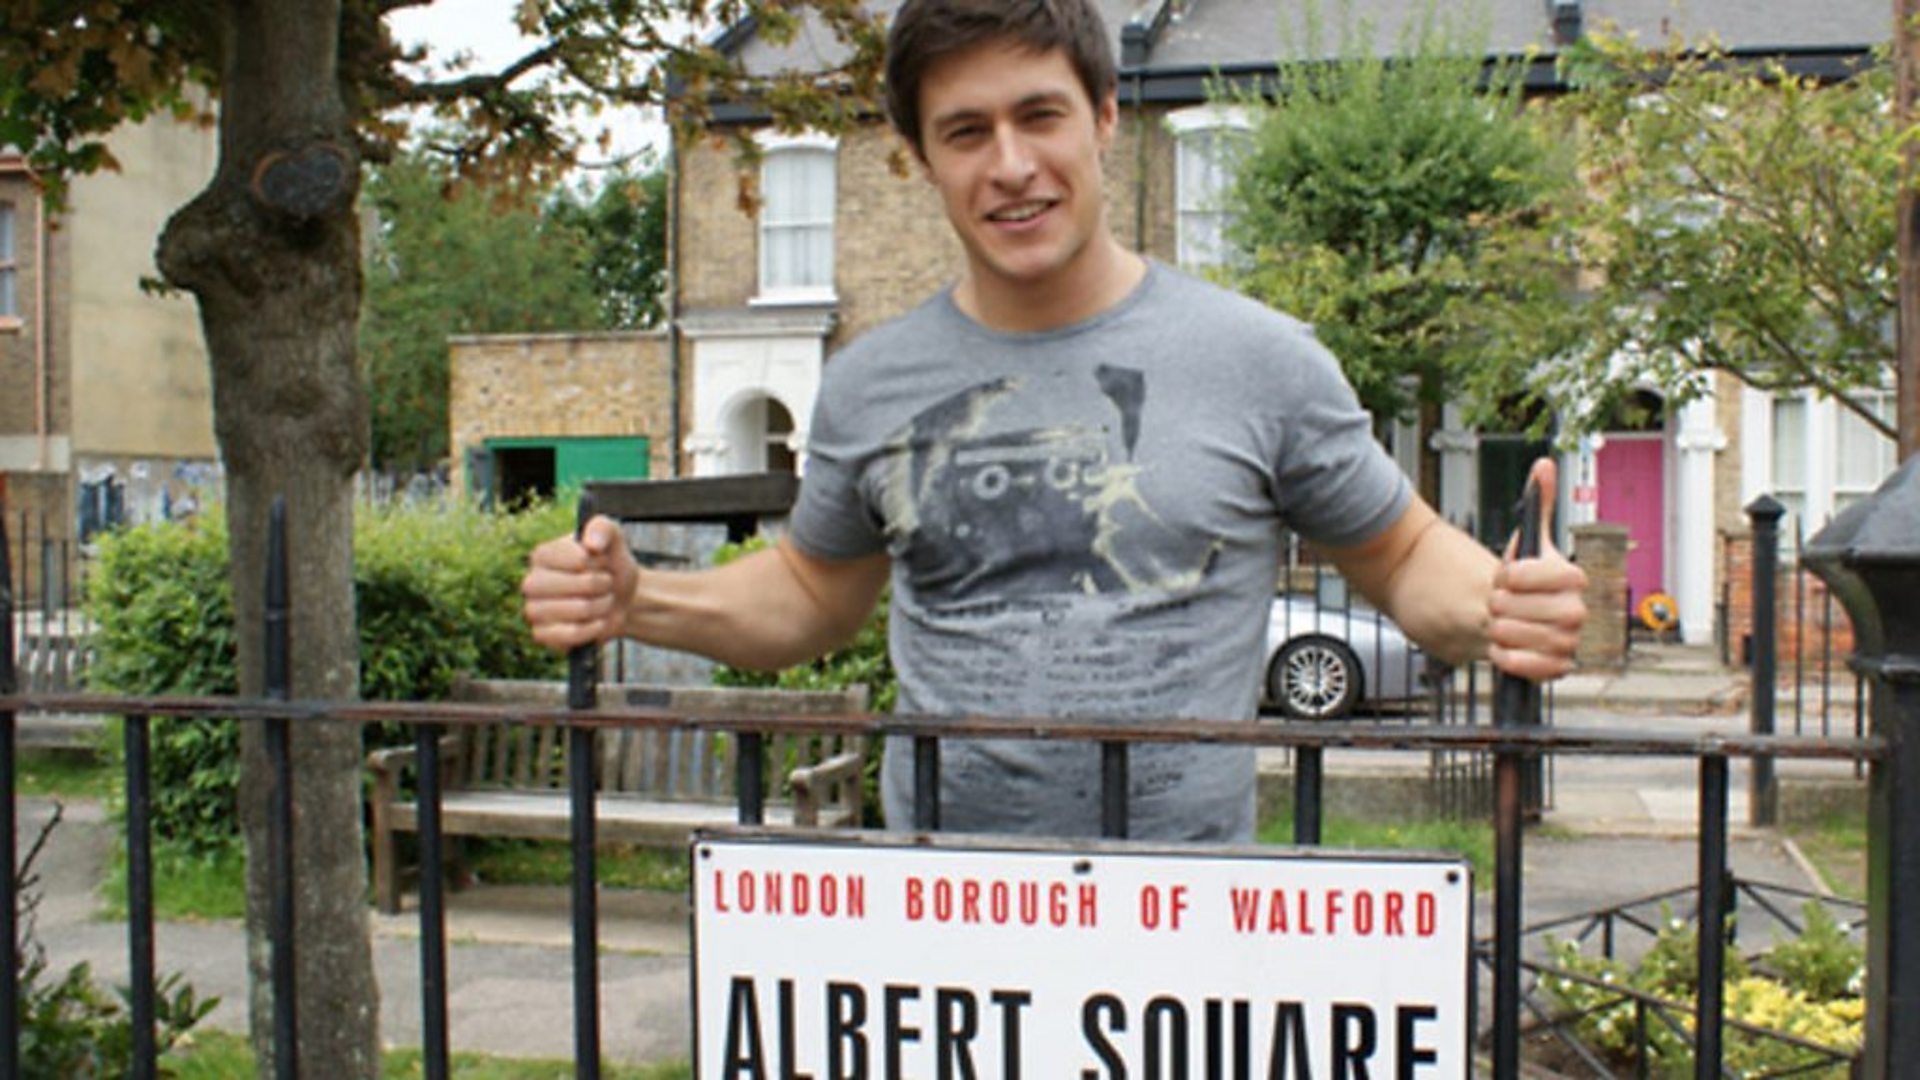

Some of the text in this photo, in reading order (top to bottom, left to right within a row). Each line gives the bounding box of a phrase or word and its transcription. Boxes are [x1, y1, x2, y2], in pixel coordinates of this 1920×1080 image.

[714, 868, 1437, 938] LONDON BOROUGH OF WALFORD
[723, 976, 1437, 1080] ALBERT SQUARE
